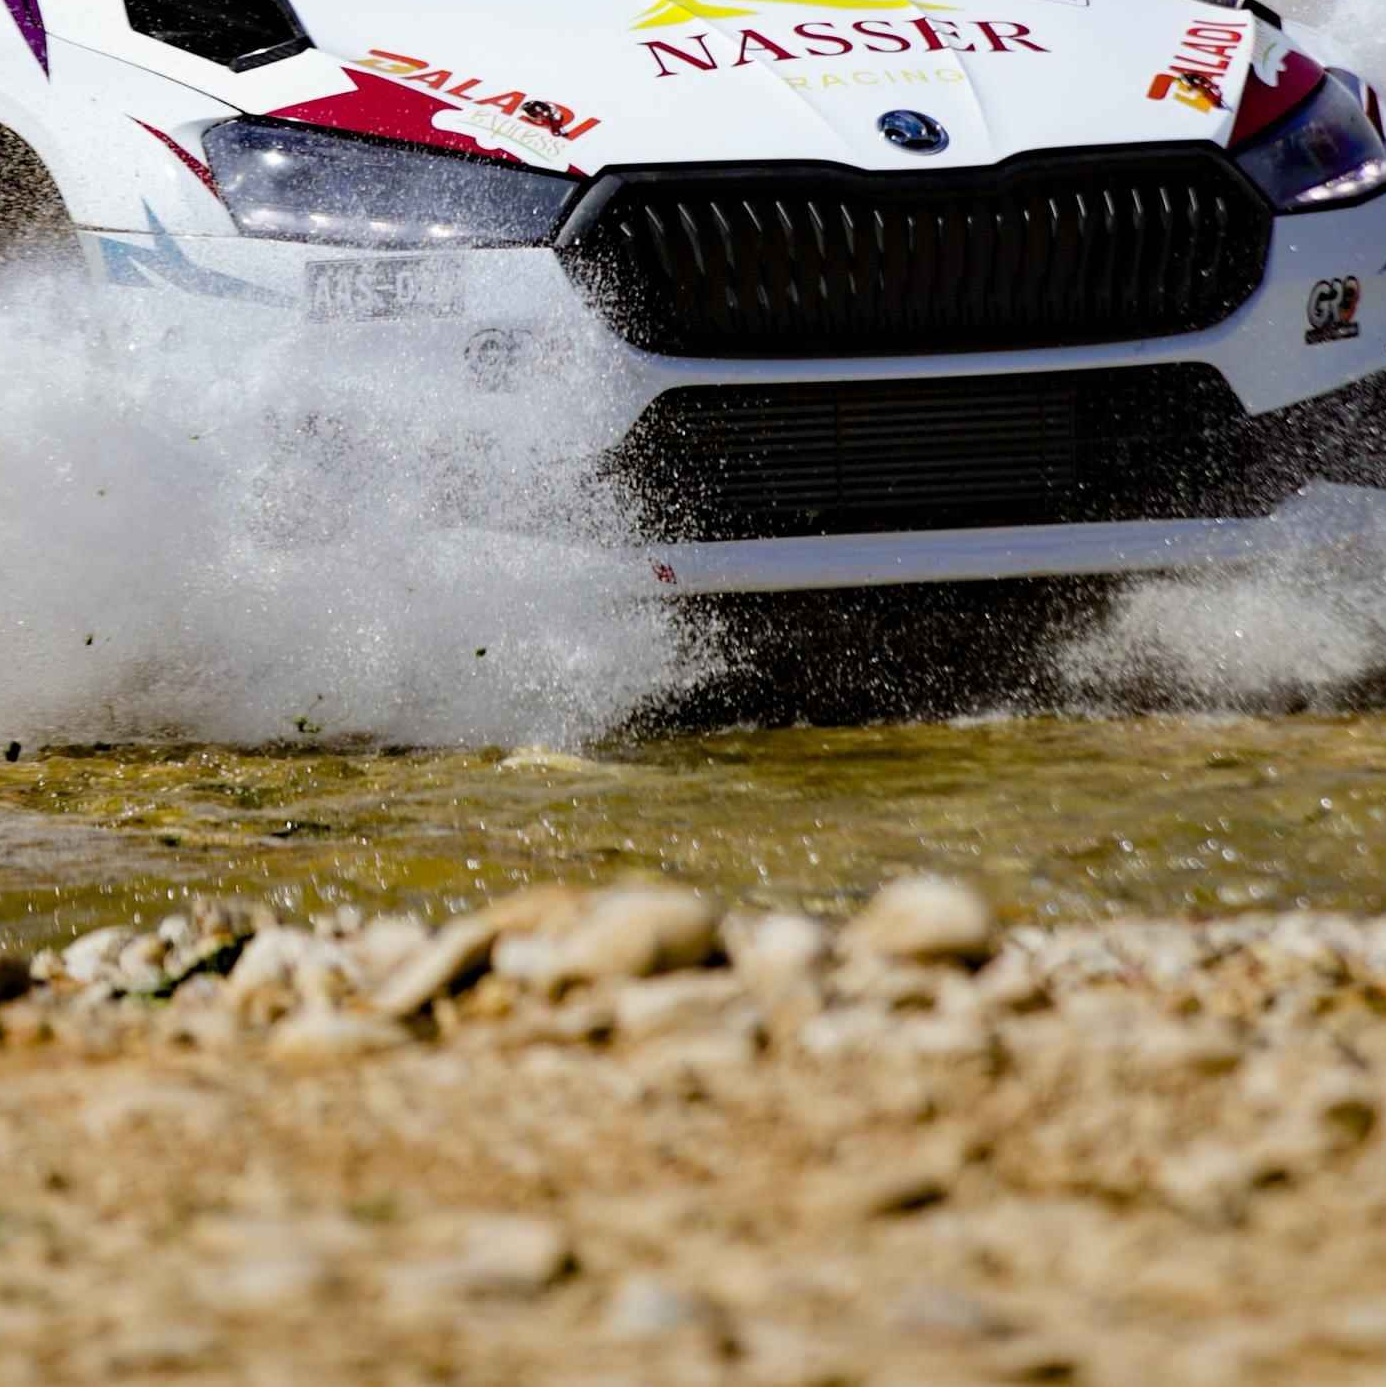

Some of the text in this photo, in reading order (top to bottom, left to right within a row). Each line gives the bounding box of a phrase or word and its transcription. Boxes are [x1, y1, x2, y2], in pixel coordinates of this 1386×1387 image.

[637, 17, 1052, 77] NASSER
[780, 67, 965, 90] RACING
[469, 109, 566, 159] express
